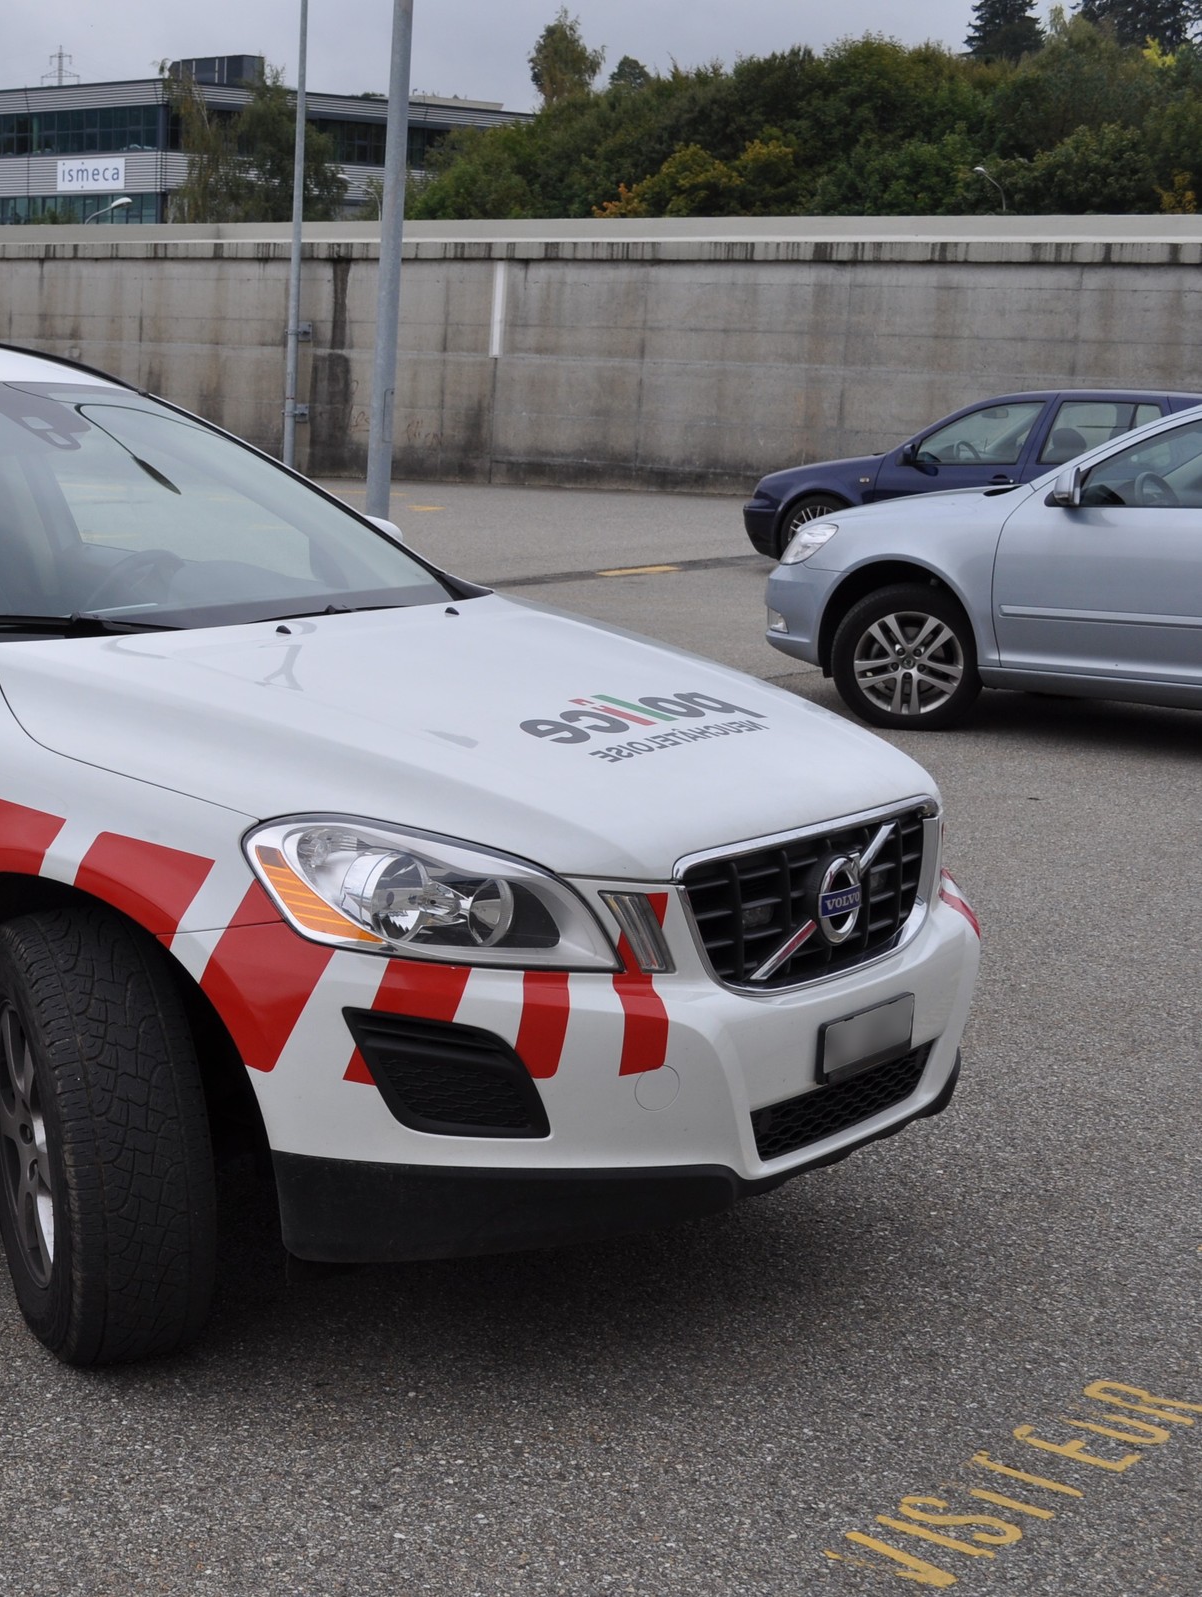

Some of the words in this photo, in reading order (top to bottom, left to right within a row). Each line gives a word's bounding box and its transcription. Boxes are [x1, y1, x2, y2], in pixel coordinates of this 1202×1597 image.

[62, 162, 120, 183] ismeca
[825, 892, 860, 910] VOLVO
[823, 1380, 1202, 1588] VISITEUR
